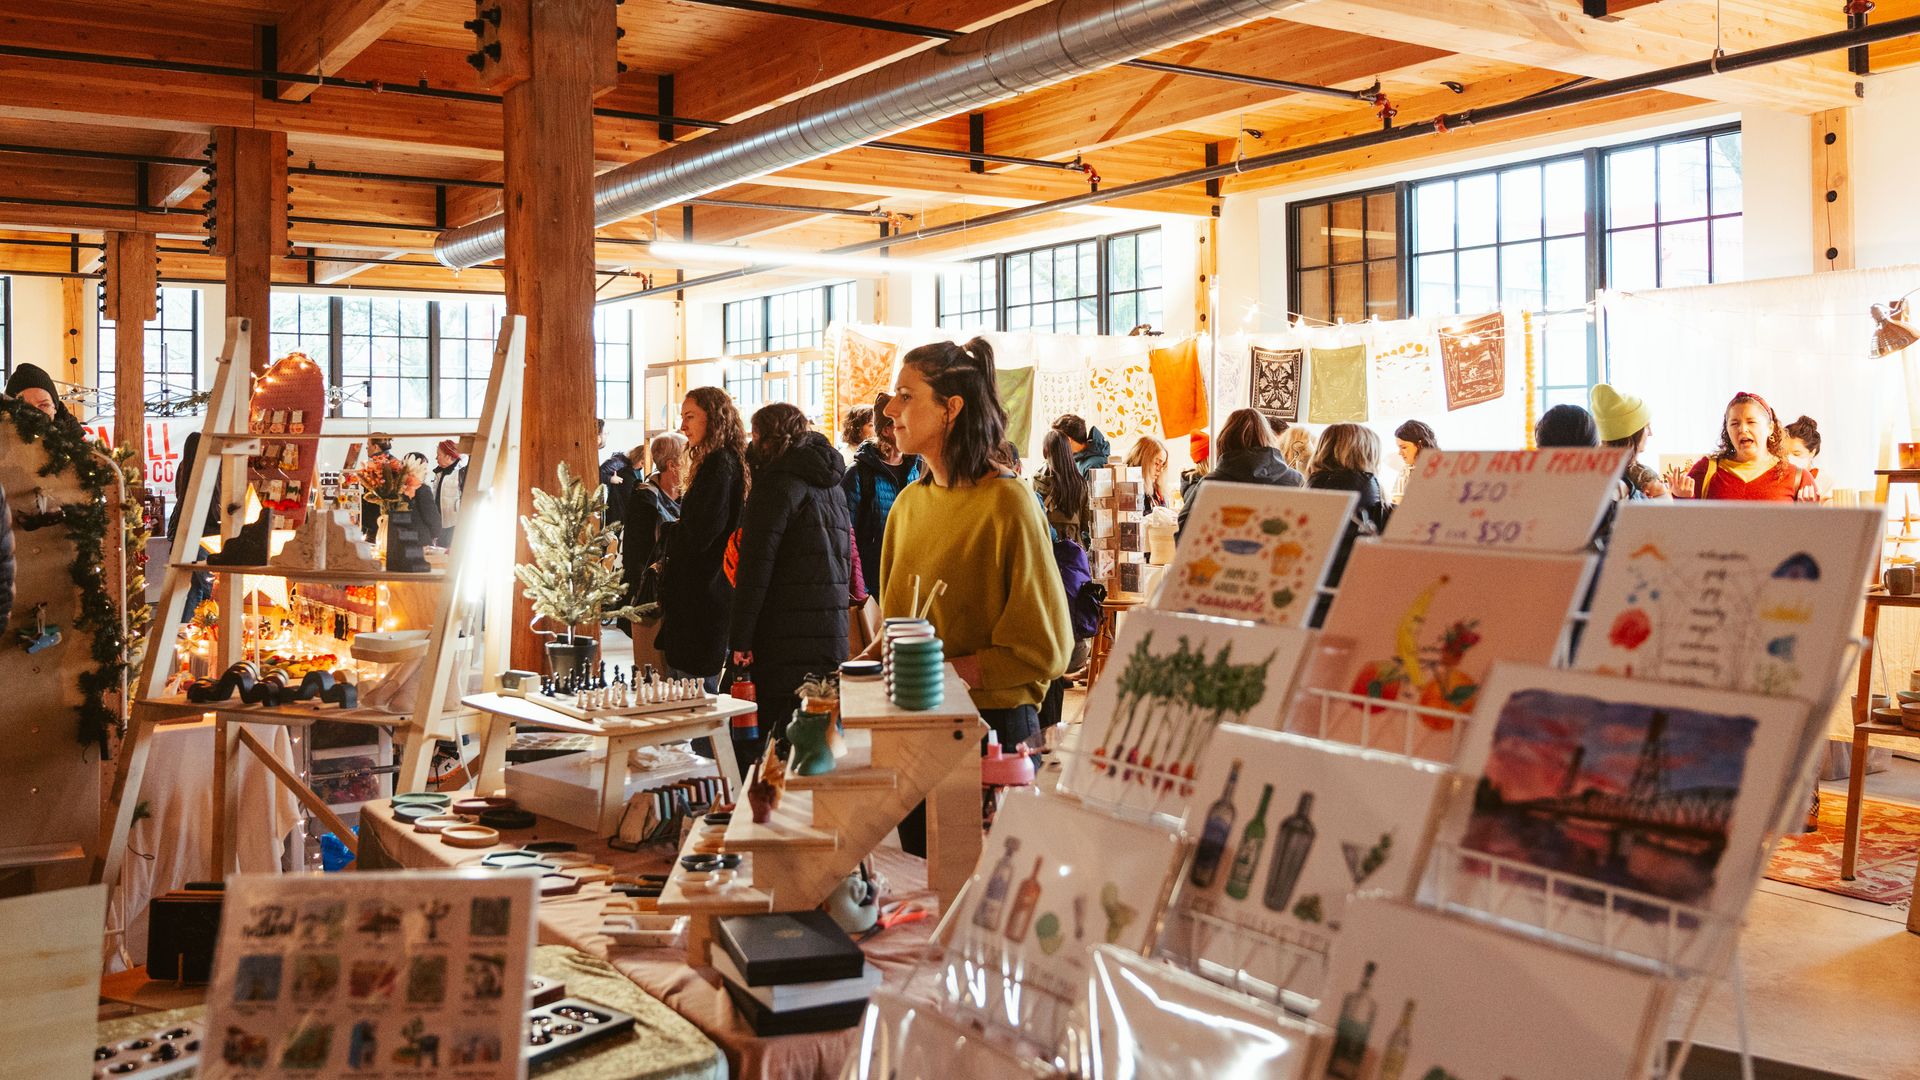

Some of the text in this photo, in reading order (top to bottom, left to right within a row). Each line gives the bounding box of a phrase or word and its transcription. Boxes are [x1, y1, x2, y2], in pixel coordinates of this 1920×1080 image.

[1485, 450, 1540, 474] ART
[1458, 481, 1508, 503] $20
[1476, 520, 1522, 544] $50
